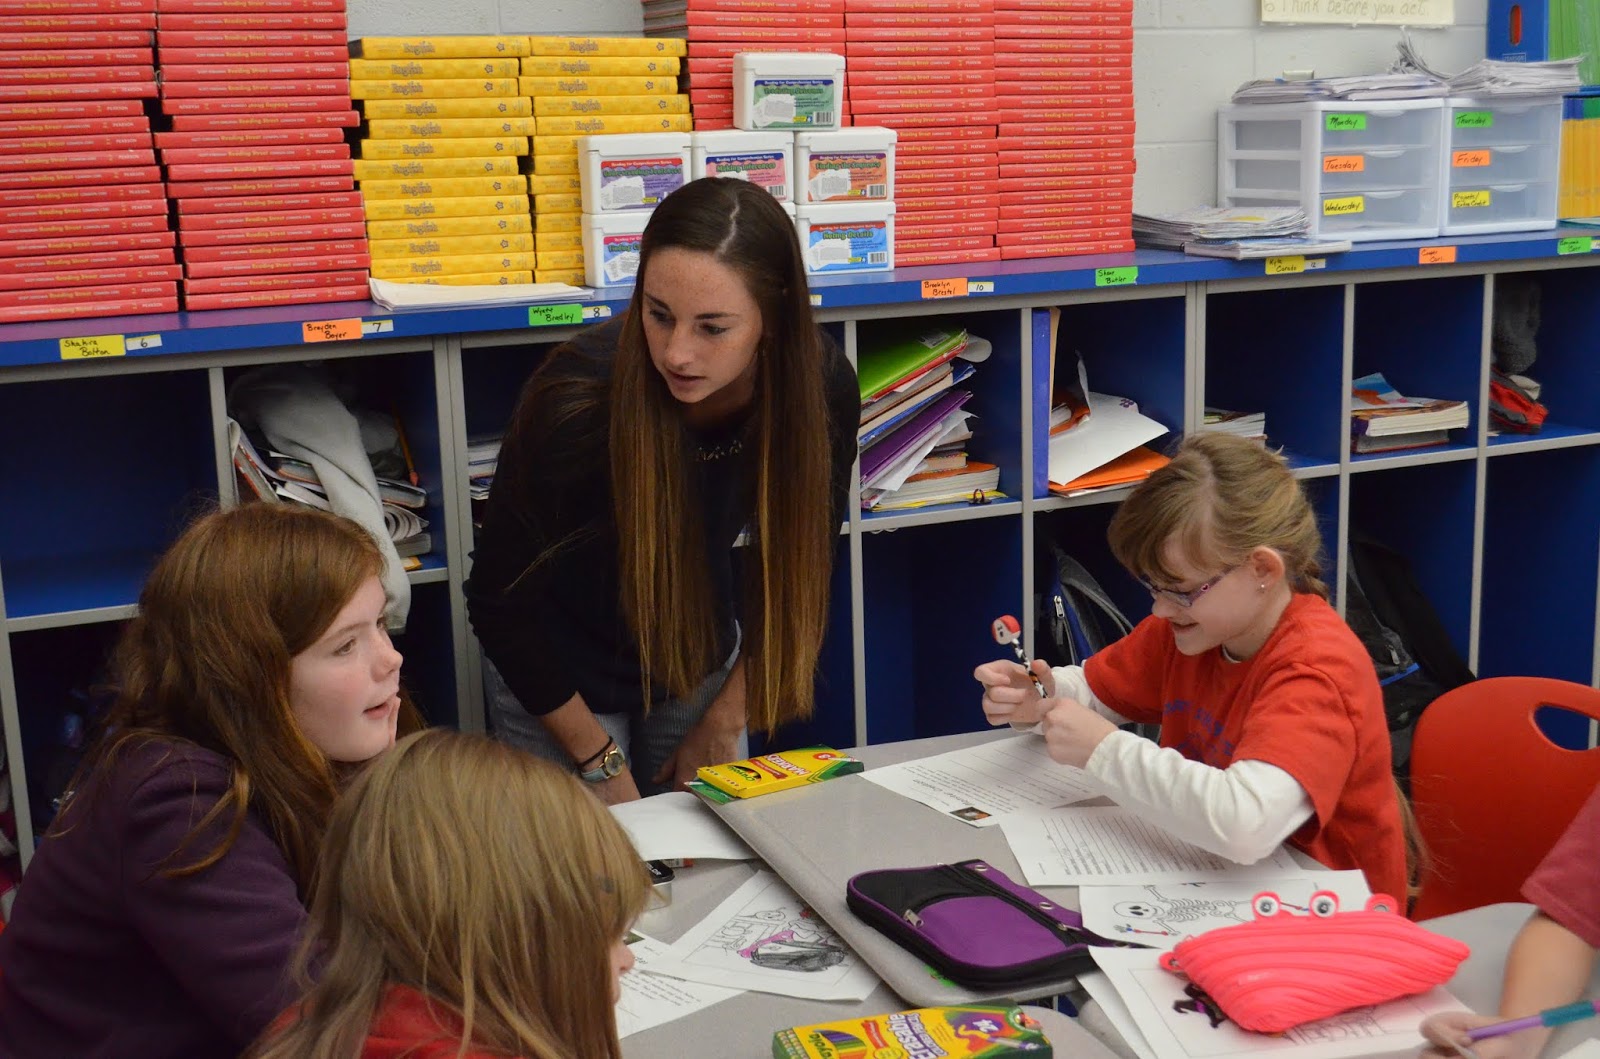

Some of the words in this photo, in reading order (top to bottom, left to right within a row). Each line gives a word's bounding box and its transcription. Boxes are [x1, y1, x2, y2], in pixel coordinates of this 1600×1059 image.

[403, 41, 436, 55] English
[569, 40, 599, 53] English
[392, 63, 423, 77] English
[560, 60, 591, 73] English
[392, 82, 423, 95] English
[558, 80, 588, 92] English
[405, 102, 437, 115] English
[572, 99, 601, 112] English
[575, 119, 604, 132] English
[1330, 118, 1357, 128] Monday
[1456, 115, 1486, 125] Thursday
[410, 122, 442, 135] English
[403, 142, 434, 155] English
[1326, 159, 1357, 170] Tuesday
[1457, 154, 1482, 164] Friday
[392, 163, 424, 176] English
[401, 182, 432, 194] English
[404, 203, 435, 216] English
[1325, 201, 1360, 212] Wednesday
[407, 221, 438, 234] English
[409, 241, 440, 253] English
[411, 261, 442, 274] English
[594, 307, 599, 318] 8
[373, 323, 381, 332] 7
[140, 338, 148, 347] 6
